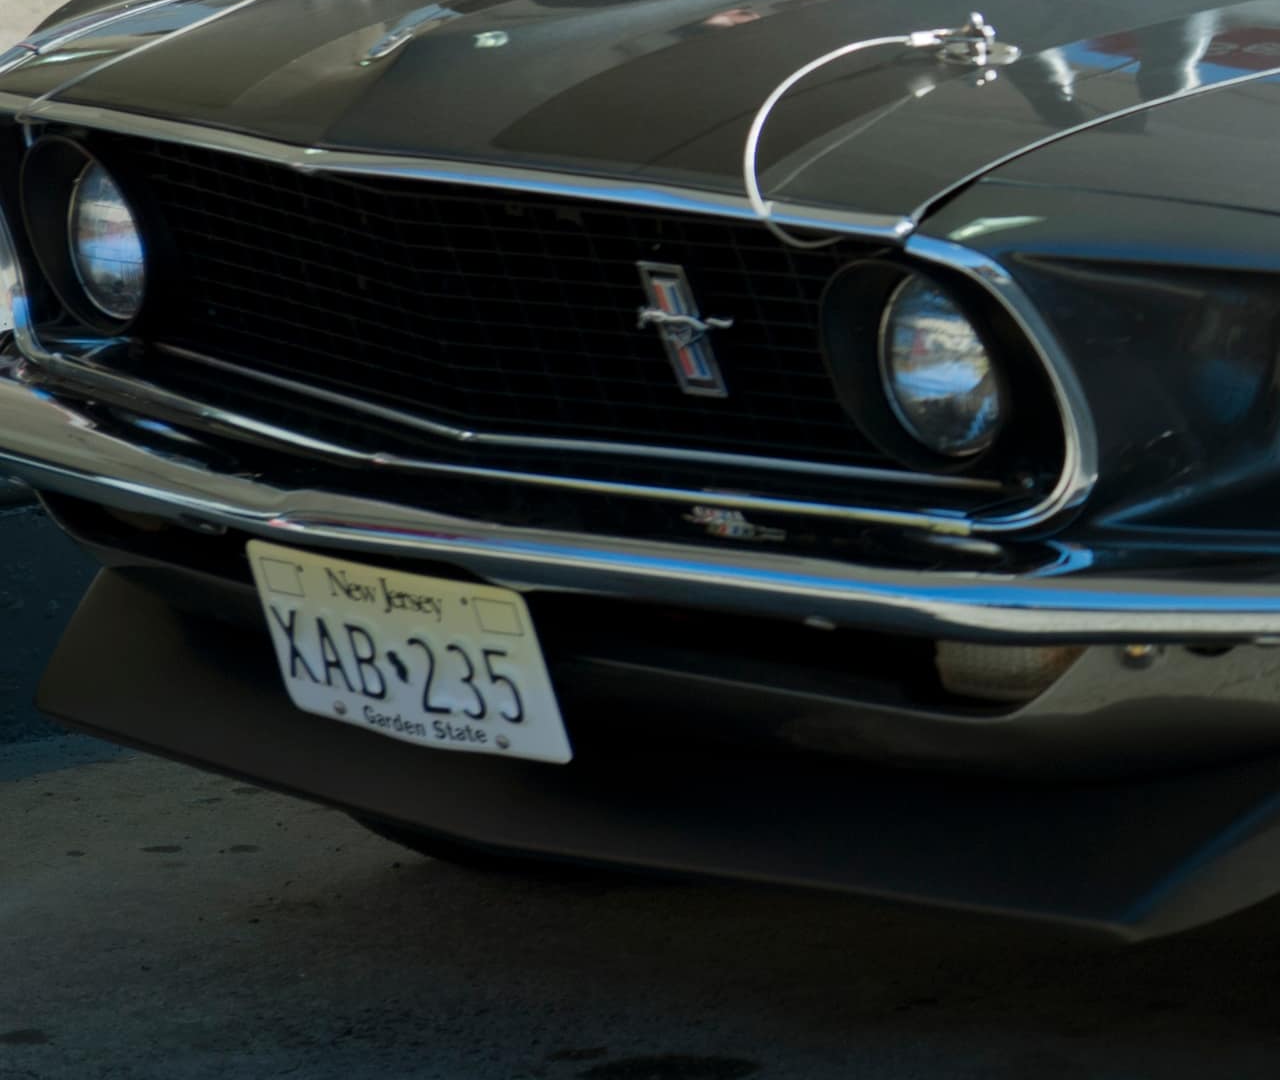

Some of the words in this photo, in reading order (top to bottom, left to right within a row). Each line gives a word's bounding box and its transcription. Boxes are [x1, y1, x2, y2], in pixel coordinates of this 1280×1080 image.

[324, 567, 377, 603] New
[379, 577, 443, 621] Jersey
[363, 704, 427, 738] Garden
[433, 720, 489, 745] State
